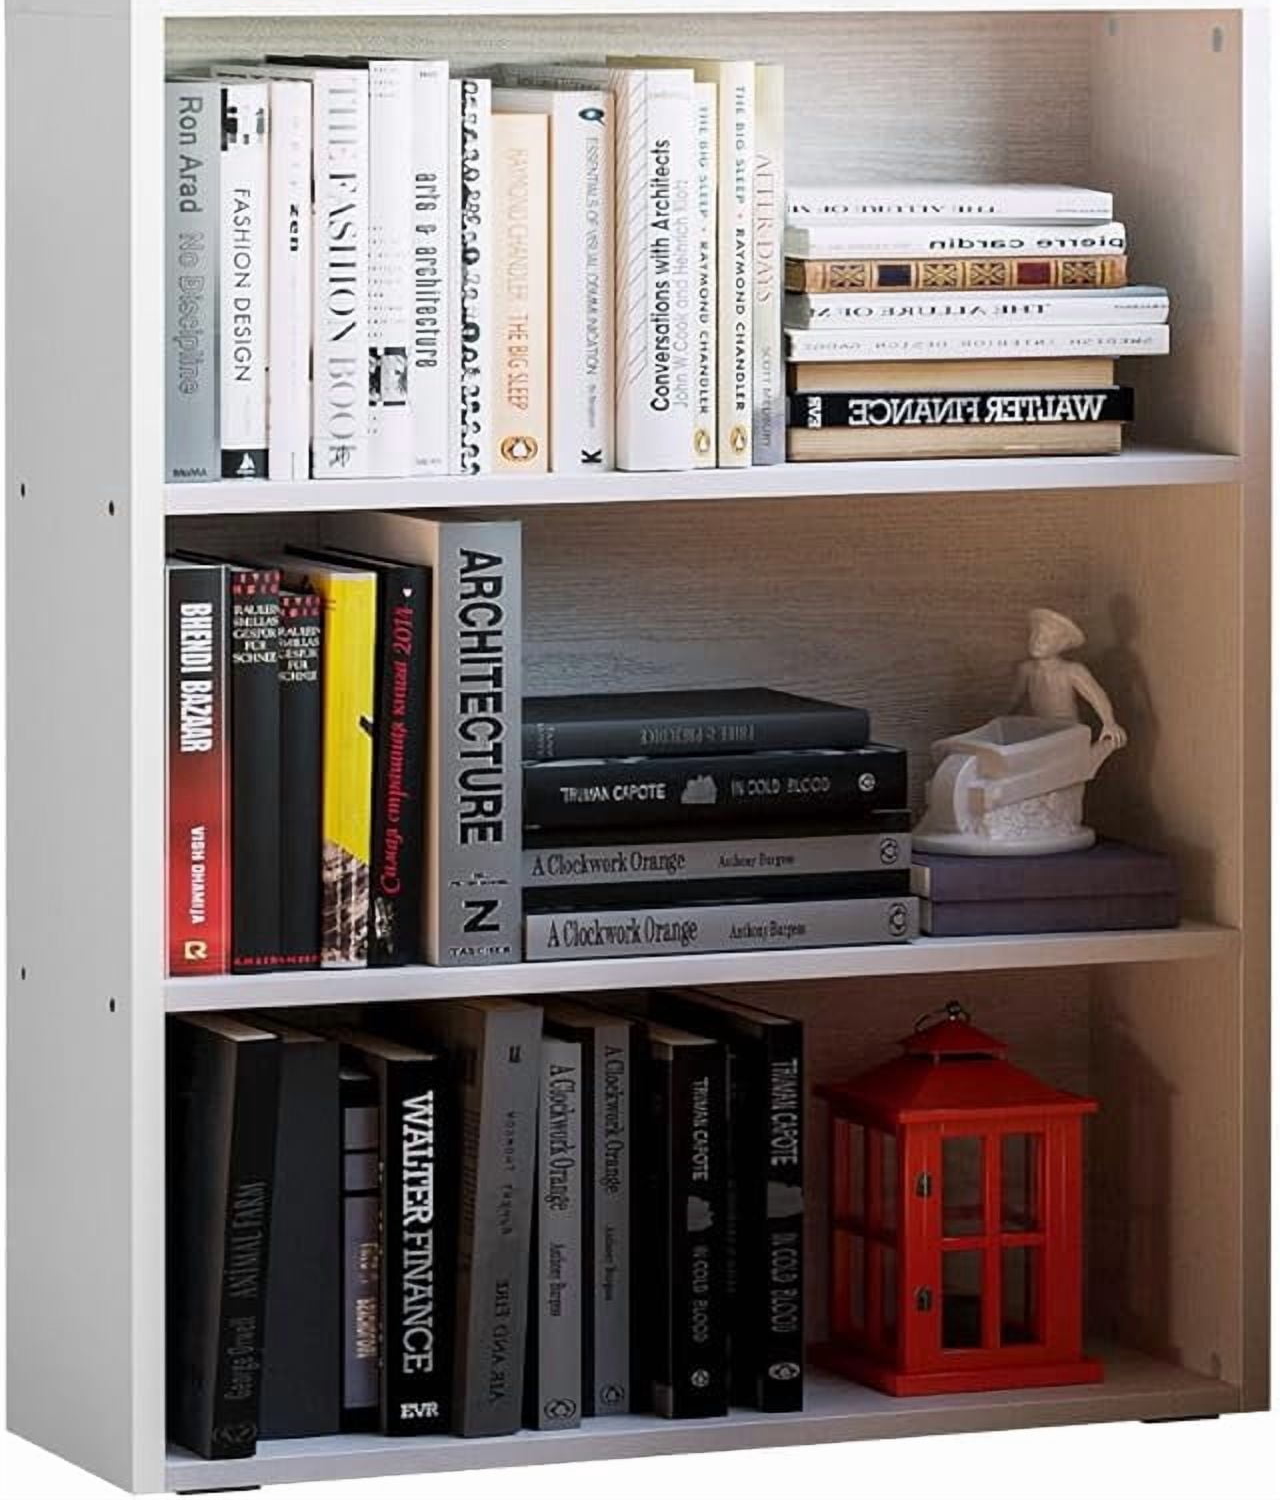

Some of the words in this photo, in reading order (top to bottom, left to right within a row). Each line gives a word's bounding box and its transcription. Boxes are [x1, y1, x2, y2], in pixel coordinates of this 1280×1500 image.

[179, 96, 203, 145] Ron
[329, 78, 357, 160] THE
[699, 106, 708, 132] THE
[736, 86, 745, 114] THE
[699, 141, 708, 167] BIG
[736, 122, 745, 150] BIG
[179, 155, 204, 214] Arad
[416, 173, 440, 211] arts
[650, 140, 670, 230] Architects
[699, 175, 708, 218] SLEEP
[736, 158, 746, 204] SLEEP
[234, 189, 252, 288] FASHION
[289, 203, 299, 252] zen
[586, 210, 599, 225] OF
[178, 231, 204, 268] No
[329, 173, 357, 341] FASHION
[650, 238, 670, 275] with
[672, 217, 688, 275] Heinrich
[736, 228, 746, 315] RAYMOND
[416, 246, 443, 368] architecture
[672, 280, 688, 309] and
[699, 241, 709, 323] RAYMOND
[172, 275, 204, 395] Discipline
[234, 298, 252, 382] DESIGN
[508, 313, 528, 340] THE
[650, 281, 670, 411] Conversations
[672, 313, 688, 352] Cook
[508, 345, 528, 368] BIG
[699, 331, 709, 413] CHANDLER
[736, 322, 746, 411] CHANDLER
[329, 357, 357, 468] BOOK
[507, 373, 528, 411] SLEEP
[672, 374, 689, 408] John
[180, 602, 213, 673] BHENDI
[393, 605, 413, 655] 2014
[180, 681, 213, 752] BAZAAR
[458, 547, 504, 846] ARCHITECTURE
[612, 783, 666, 800] CAPOTE
[190, 826, 205, 860] VISH
[532, 858, 545, 877] A
[546, 853, 628, 876] Clockwork
[631, 850, 686, 875] Orange
[189, 864, 205, 924] DHAMIJA
[547, 920, 561, 947] A
[563, 917, 642, 947] Clockwork
[644, 916, 699, 946] Orange
[729, 922, 768, 940] Anthony
[549, 1064, 574, 1078] A
[605, 1045, 624, 1058] A
[549, 1078, 577, 1156] Clockwork
[605, 1059, 625, 1138] Clockwork
[402, 1090, 434, 1232] WALTER
[692, 1130, 710, 1181] CAPOTE
[770, 1111, 799, 1166] CAPOTE
[544, 1158, 575, 1211] Orange
[600, 1140, 624, 1193] Orange
[402, 1231, 434, 1375] FINANCE
[400, 1402, 439, 1419] EVR
